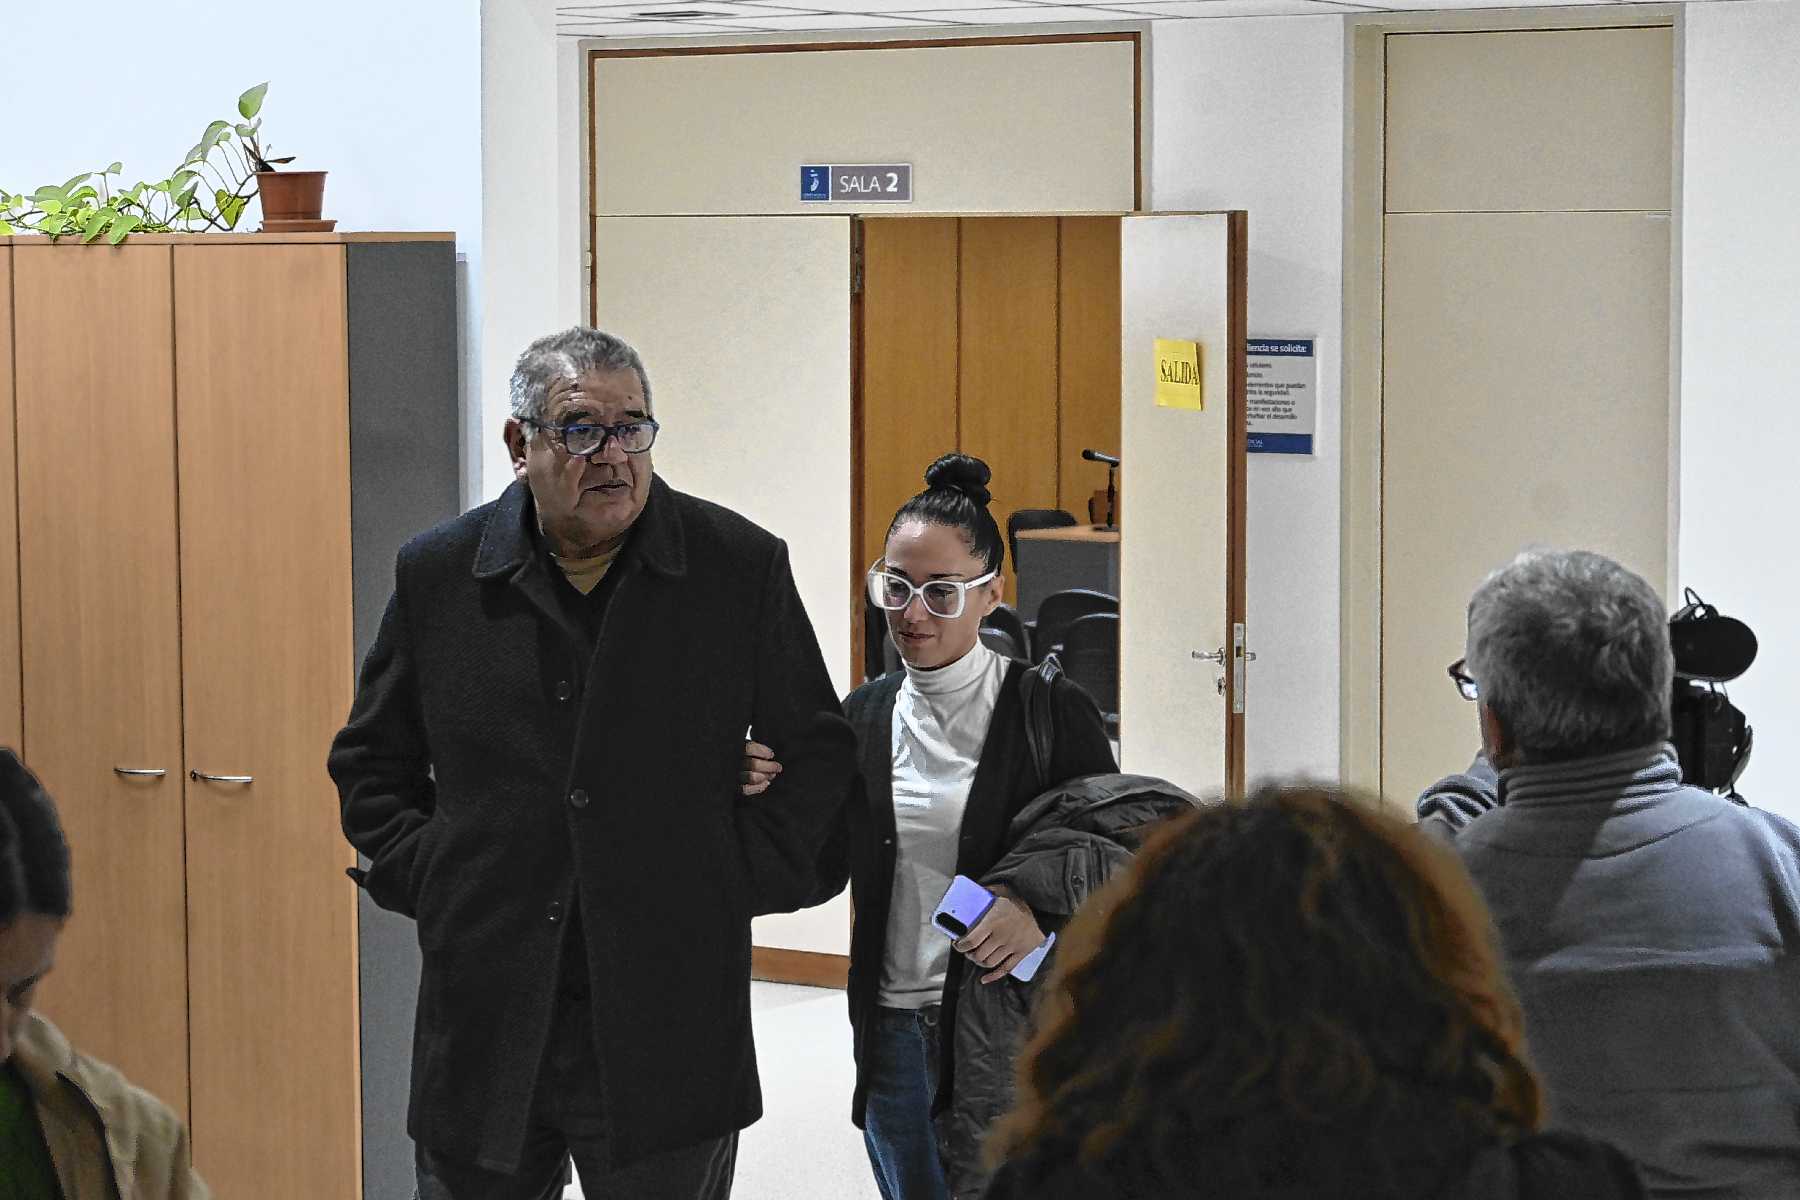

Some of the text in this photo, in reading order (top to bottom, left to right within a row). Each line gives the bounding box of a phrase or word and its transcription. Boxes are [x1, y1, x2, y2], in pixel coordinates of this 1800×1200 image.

[840, 172, 898, 193] SALA 2
[1160, 359, 1199, 386] SALIDA
